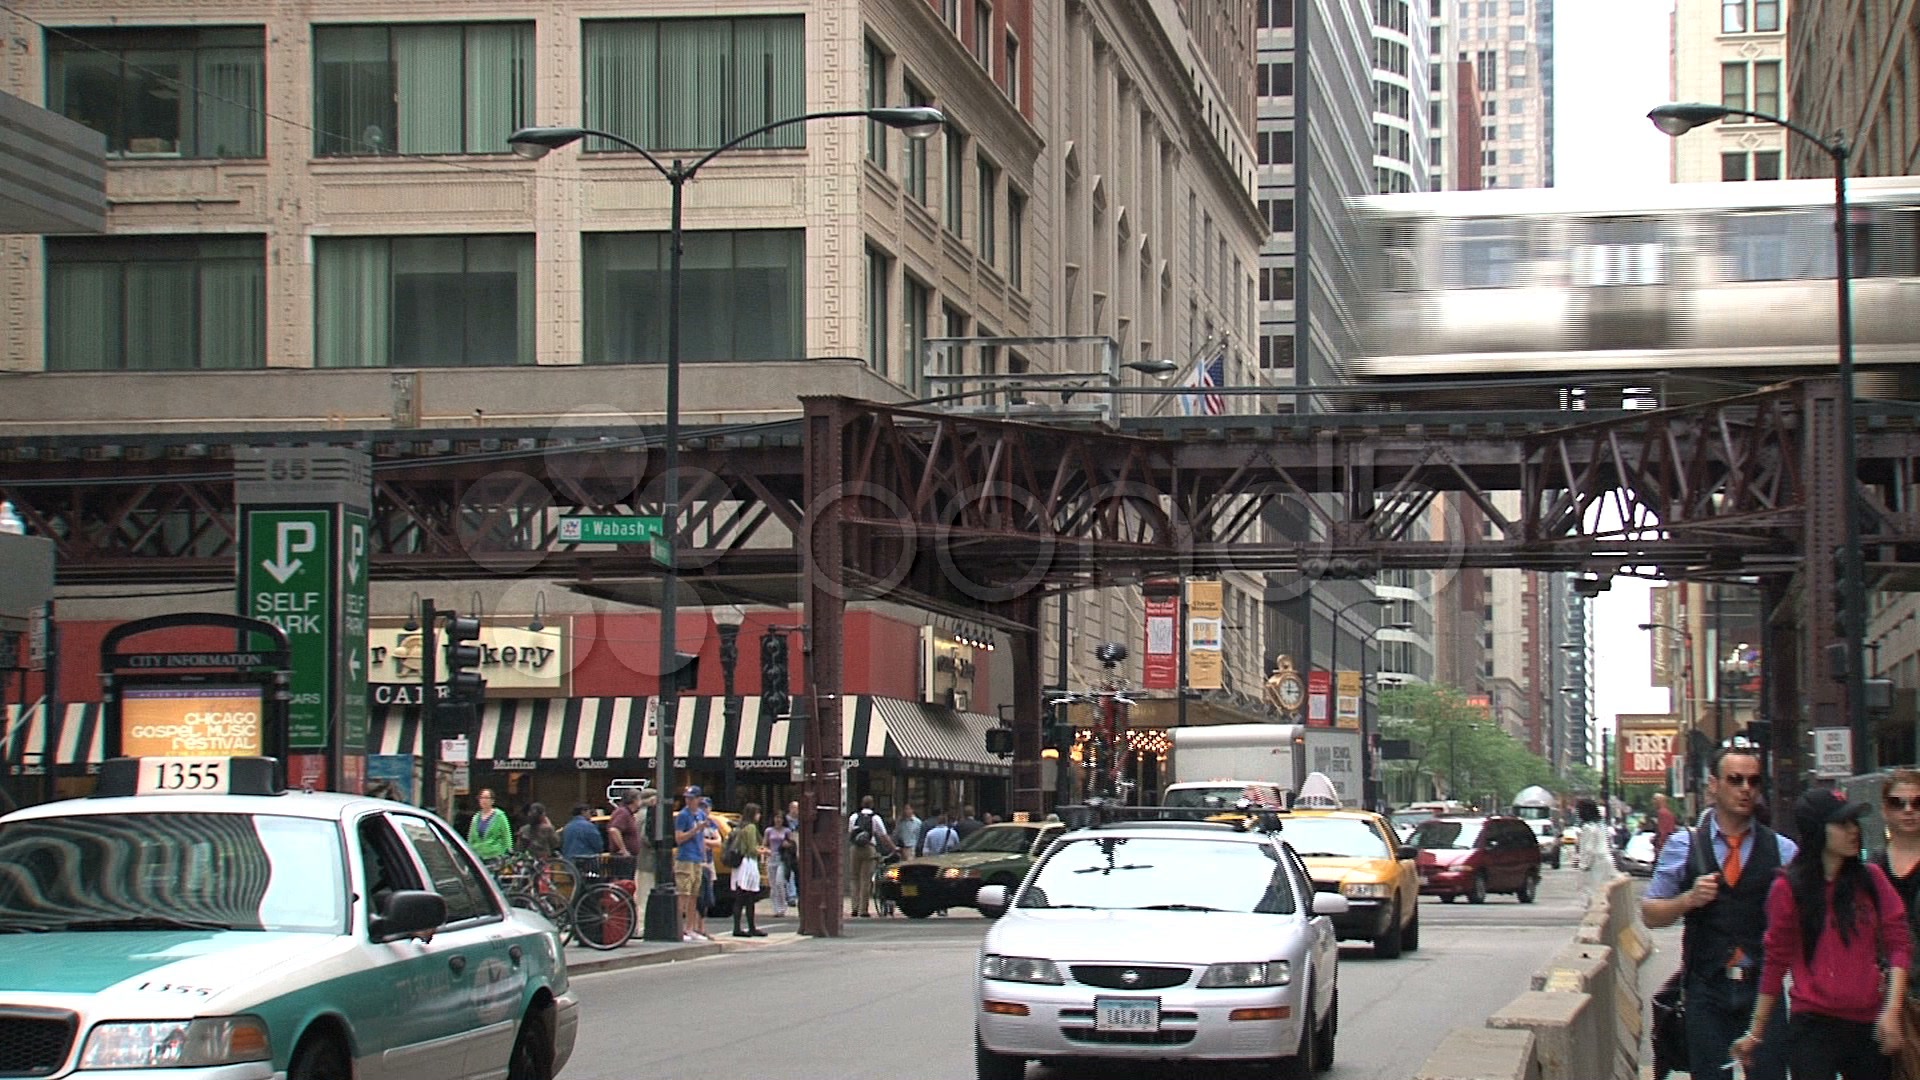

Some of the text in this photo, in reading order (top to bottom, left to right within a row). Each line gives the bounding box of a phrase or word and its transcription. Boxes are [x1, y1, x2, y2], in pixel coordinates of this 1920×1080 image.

[593, 521, 644, 535] Wabash
[256, 592, 320, 612] SELF
[130, 654, 262, 667] CITY INFORMATION
[289, 693, 320, 704] ARS
[184, 711, 257, 725] CHICAGO
[207, 725, 257, 737] MUSIC
[1625, 735, 1673, 753] JERSEY
[493, 759, 536, 769] Muffins
[576, 758, 609, 769] Cakes
[735, 758, 787, 770] appuccino
[1633, 753, 1666, 771] BOYS
[155, 763, 220, 790] 1355
[138, 982, 212, 996] 1355
